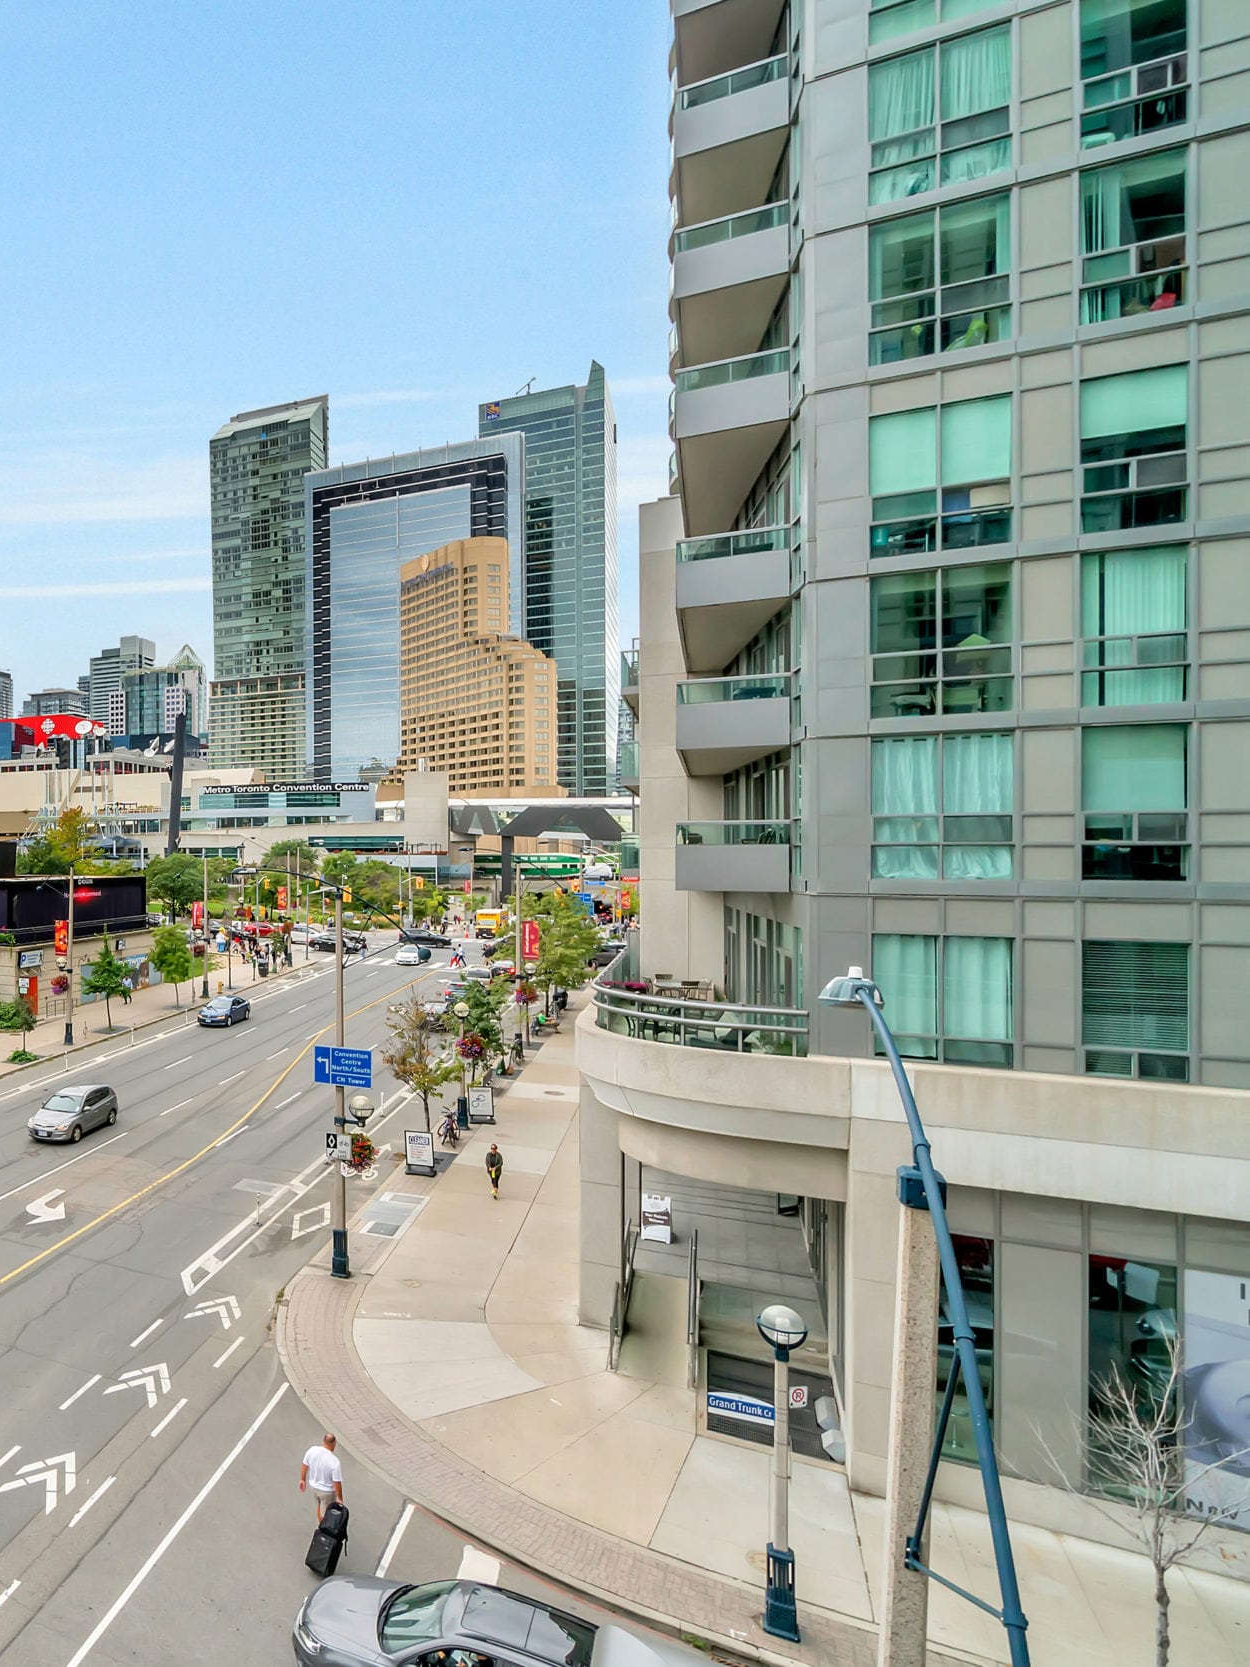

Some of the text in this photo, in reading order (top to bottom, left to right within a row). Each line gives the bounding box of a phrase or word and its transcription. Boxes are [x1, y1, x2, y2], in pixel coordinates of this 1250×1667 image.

[203, 783, 369, 794] Metro Toronto Convention Centre
[334, 1050, 369, 1059] Convention
[341, 1058, 362, 1066] Centre
[331, 1064, 371, 1073] North/South
[348, 1077, 366, 1085] Tower
[709, 1396, 772, 1418] Grand Trunk Cr
